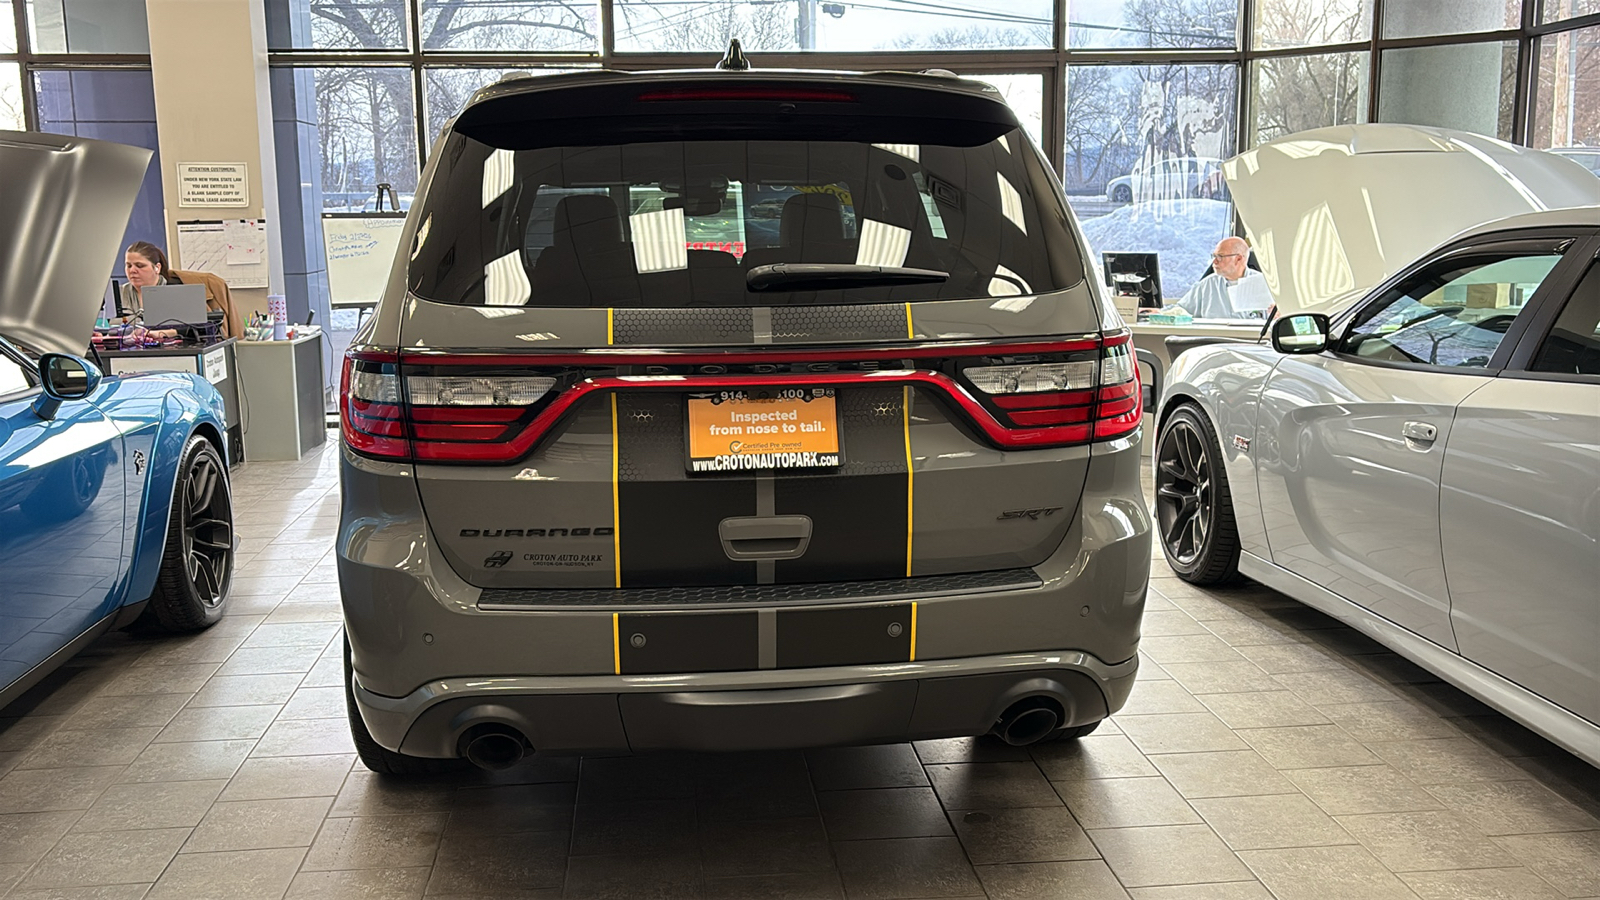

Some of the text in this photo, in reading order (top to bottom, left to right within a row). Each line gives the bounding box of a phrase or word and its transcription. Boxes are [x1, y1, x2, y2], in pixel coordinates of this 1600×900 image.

[646, 361, 880, 375] DODGE
[730, 409, 798, 424] Inspected
[709, 421, 827, 436] from nose to tail.
[997, 506, 1064, 520] SRT
[459, 528, 614, 537] DURANGO
[524, 553, 603, 562] CROTON AUTO PARK
